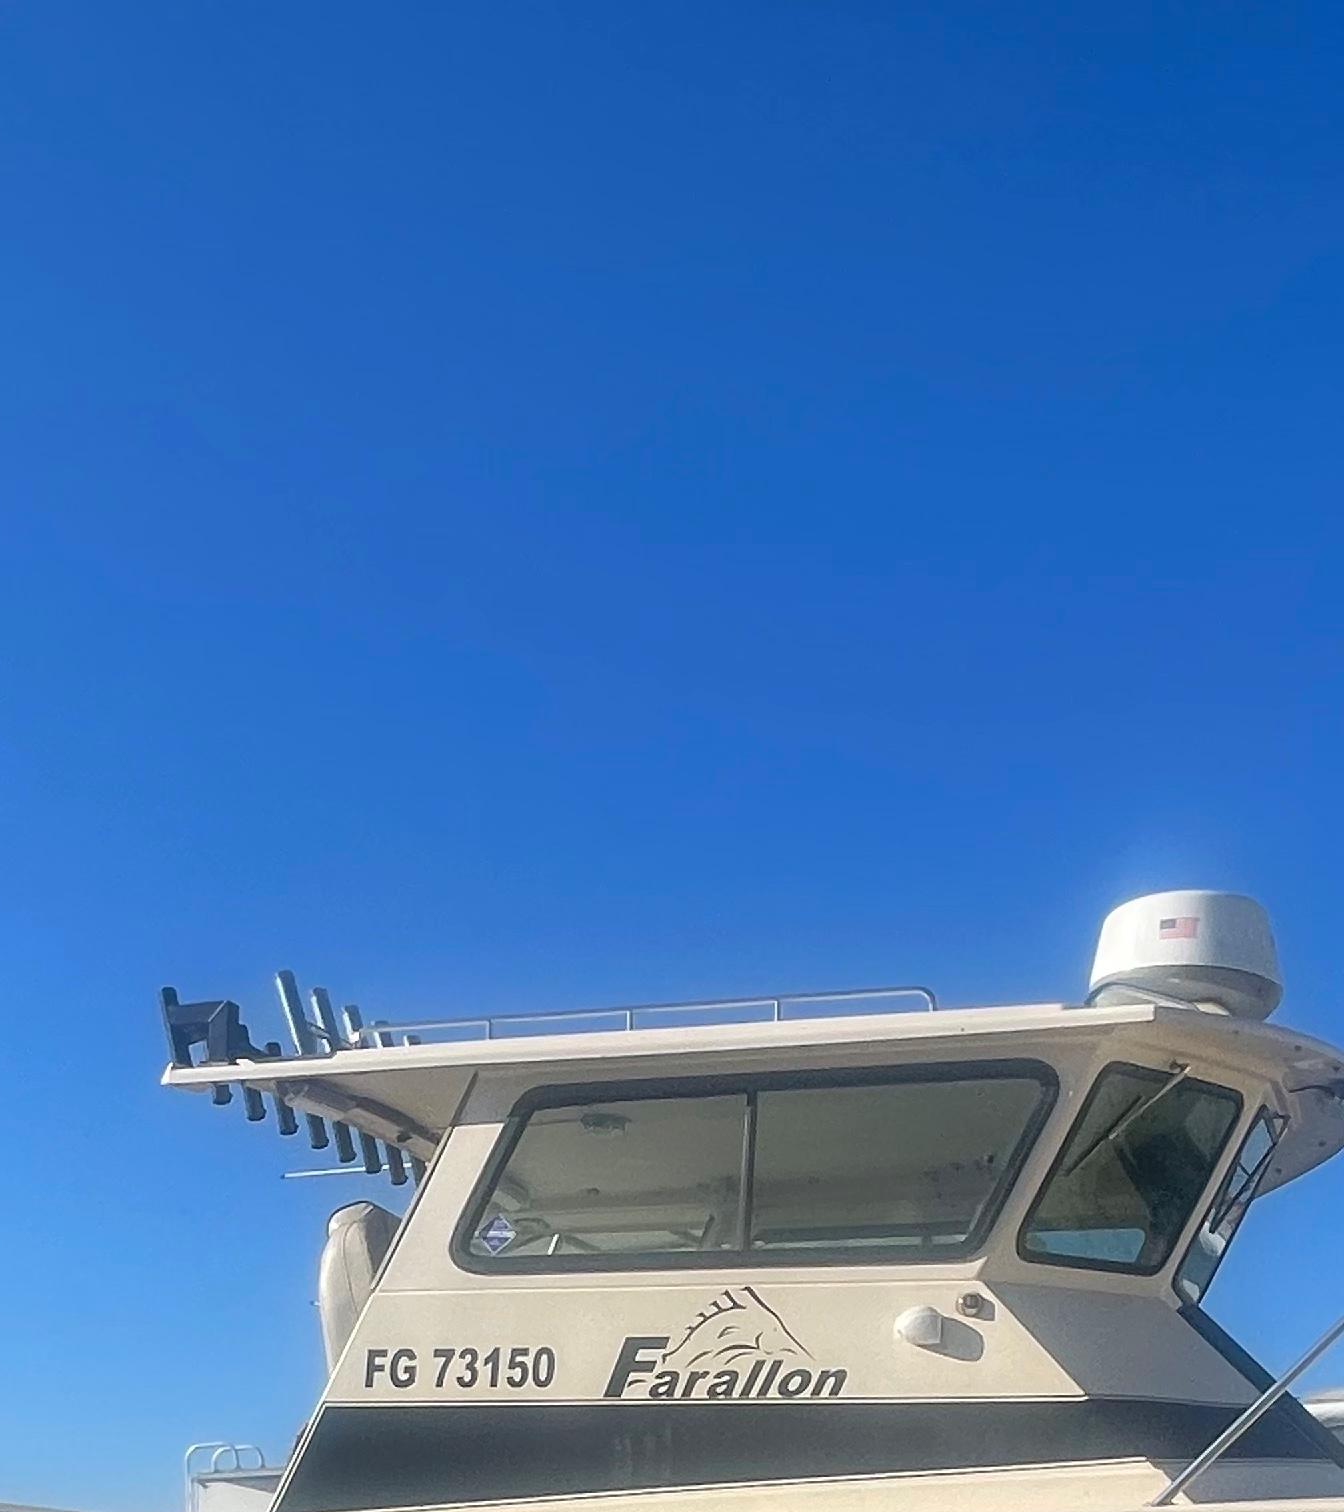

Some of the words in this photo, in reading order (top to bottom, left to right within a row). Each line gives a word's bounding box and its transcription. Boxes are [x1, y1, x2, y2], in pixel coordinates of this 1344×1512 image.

[364, 1348, 416, 1389] FG
[432, 1346, 556, 1389] 73150
[602, 1336, 848, 1399] Farallon
